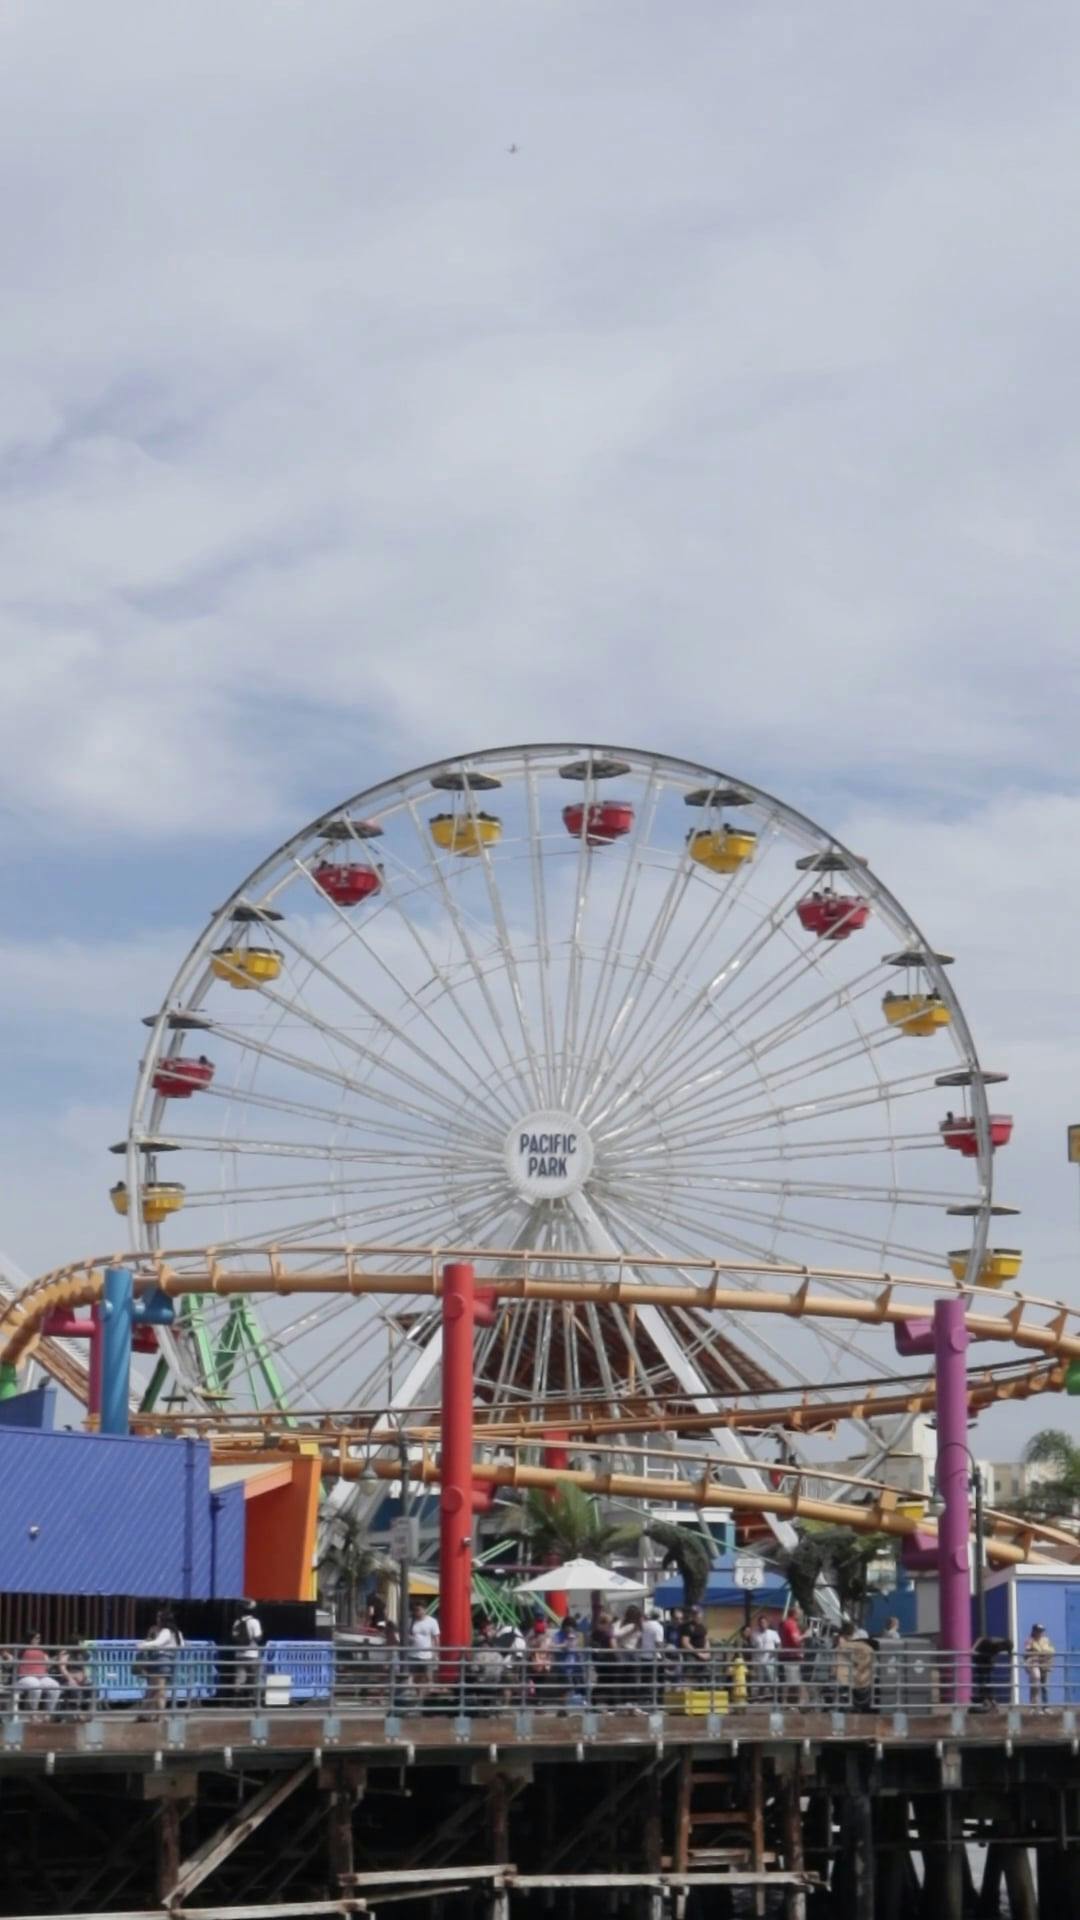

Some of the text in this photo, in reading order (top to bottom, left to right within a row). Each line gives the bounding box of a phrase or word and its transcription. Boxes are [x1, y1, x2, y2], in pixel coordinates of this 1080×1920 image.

[520, 1133, 577, 1154] PACIFIC
[528, 1156, 567, 1177] PARK
[742, 1574, 758, 1586] 66
